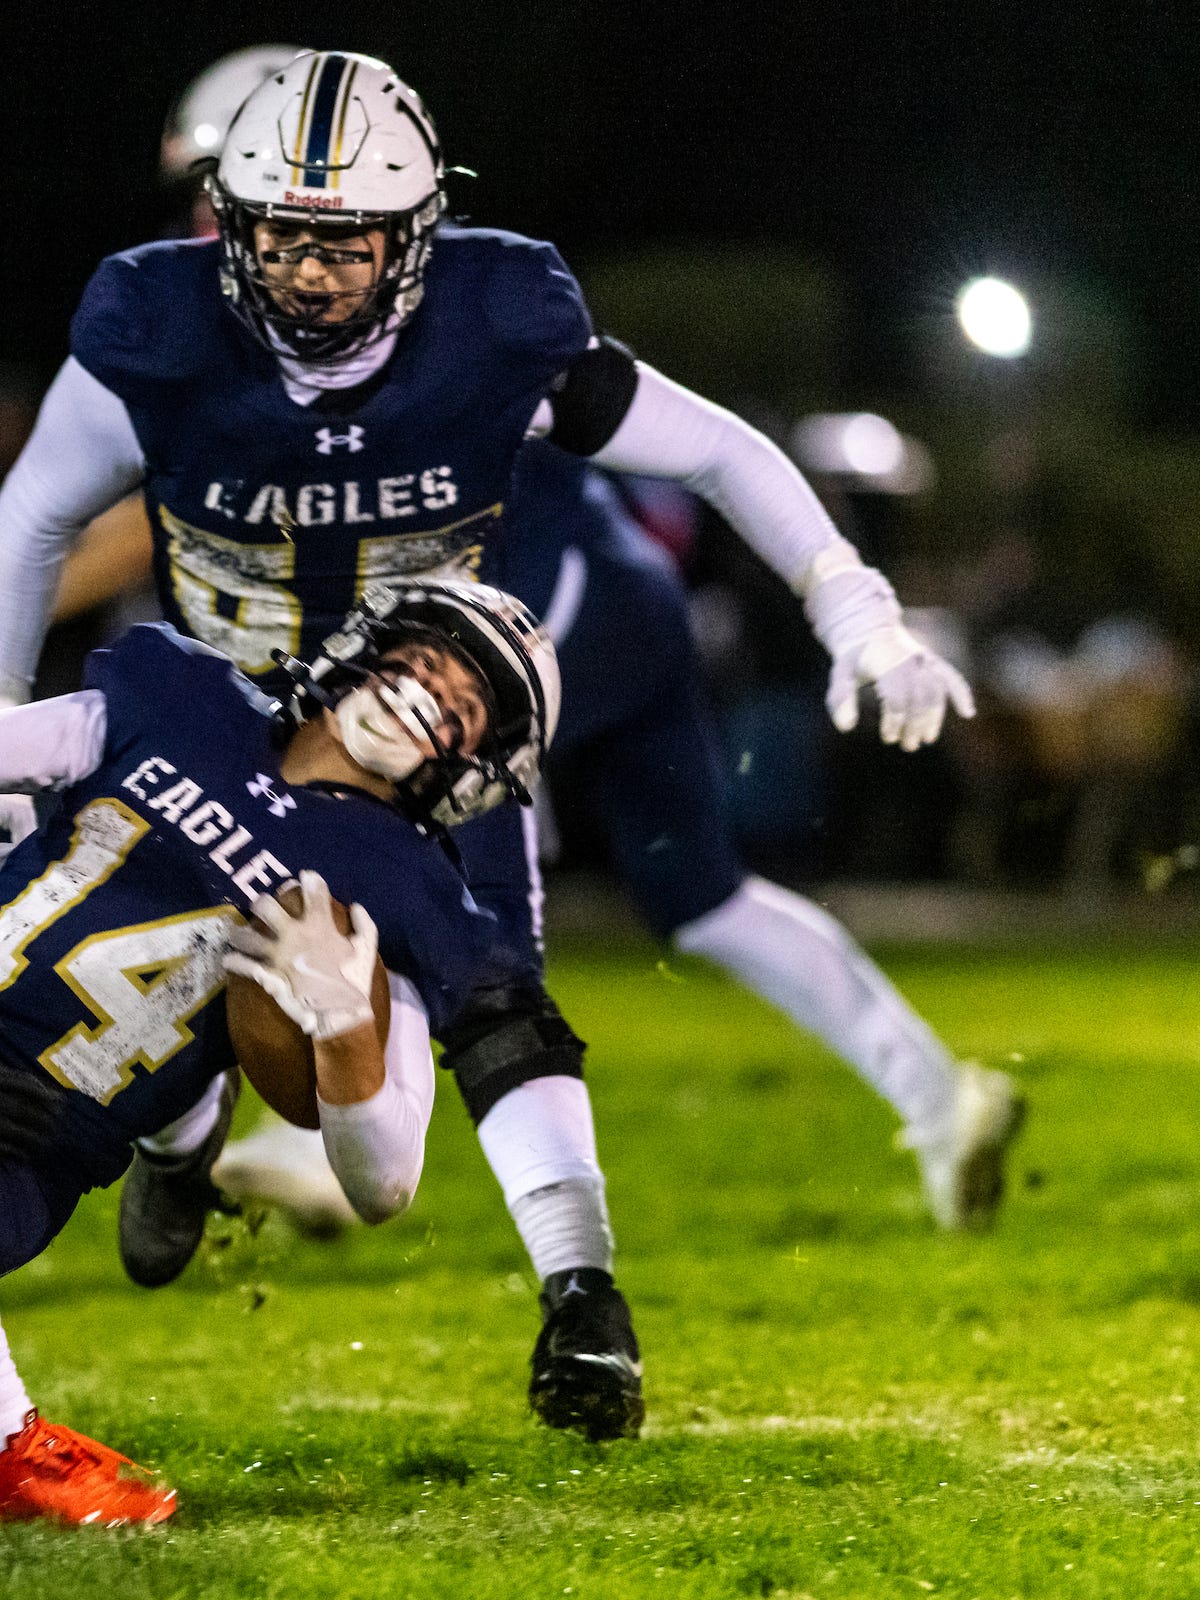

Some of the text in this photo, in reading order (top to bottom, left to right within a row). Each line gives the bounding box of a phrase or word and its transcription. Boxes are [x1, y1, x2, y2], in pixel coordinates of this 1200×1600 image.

[284, 191, 343, 208] Riddell
[204, 465, 458, 527] EAGLES
[121, 756, 294, 905] EAGLE
